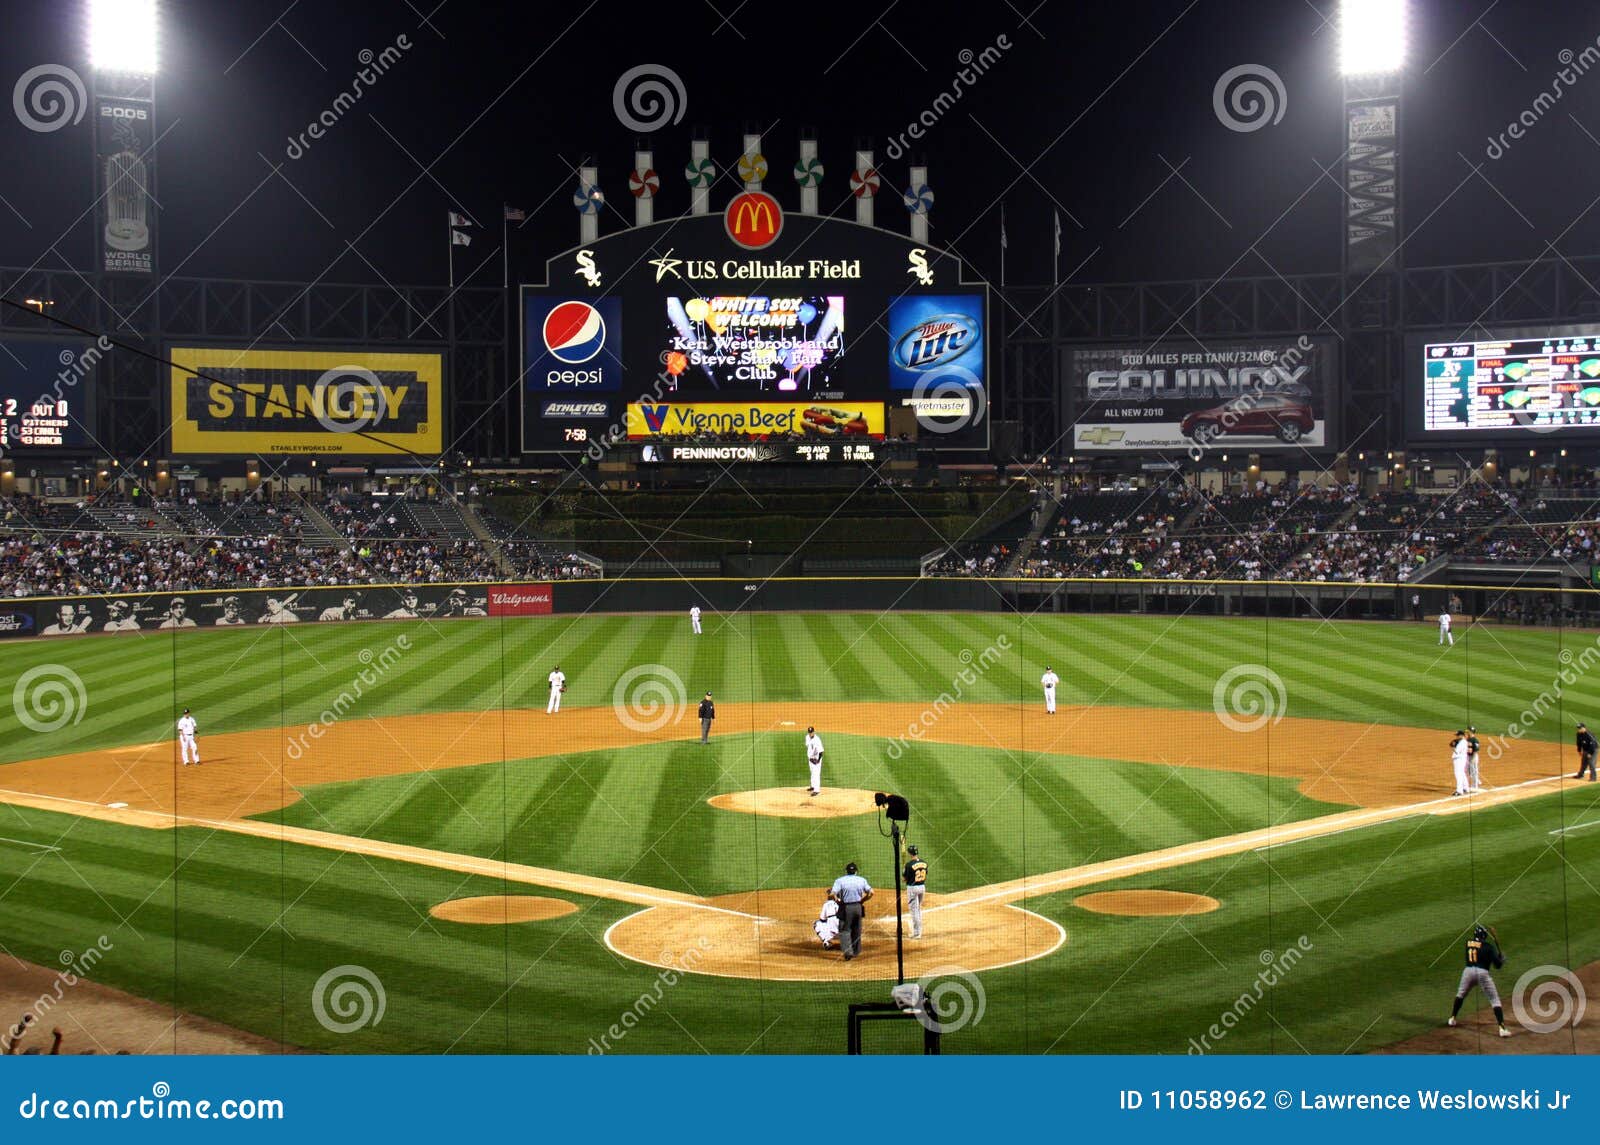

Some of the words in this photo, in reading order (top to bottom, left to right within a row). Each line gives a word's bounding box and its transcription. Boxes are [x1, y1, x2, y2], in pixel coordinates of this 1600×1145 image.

[101, 106, 147, 120] 2005
[105, 252, 151, 260] WORLD
[686, 260, 718, 279] U.S.
[722, 260, 805, 279] Cellular
[808, 260, 861, 279] Field
[711, 298, 766, 312] WHITE
[769, 298, 803, 312] SOX
[714, 314, 799, 328] WELCOME
[673, 337, 708, 350] Ken
[713, 336, 803, 350] Westbrook
[806, 337, 838, 350] and
[907, 329, 968, 368] Lite
[690, 352, 736, 367] Steve
[741, 352, 786, 365] Shaw
[1121, 354, 1143, 366] 600
[1146, 354, 1179, 365] MILES
[1182, 353, 1202, 364] PER
[1481, 360, 1504, 368] FINAL
[1556, 356, 1580, 364] FINAL
[547, 368, 603, 387] pepsi
[735, 367, 777, 381] Club
[1481, 387, 1504, 395] FINAL
[6, 399, 17, 416] 2
[32, 404, 55, 417] OUT
[57, 400, 68, 417] 0
[208, 384, 409, 419] STANLEY
[674, 408, 745, 430] Vienna
[751, 408, 796, 431] Beef
[1104, 408, 1119, 417] ALL
[1121, 408, 1141, 417] NEW
[1143, 408, 1164, 417] 2010
[564, 429, 587, 441] 7:58
[673, 447, 757, 460] PENNINGTON
[492, 593, 549, 607] Walgreens
